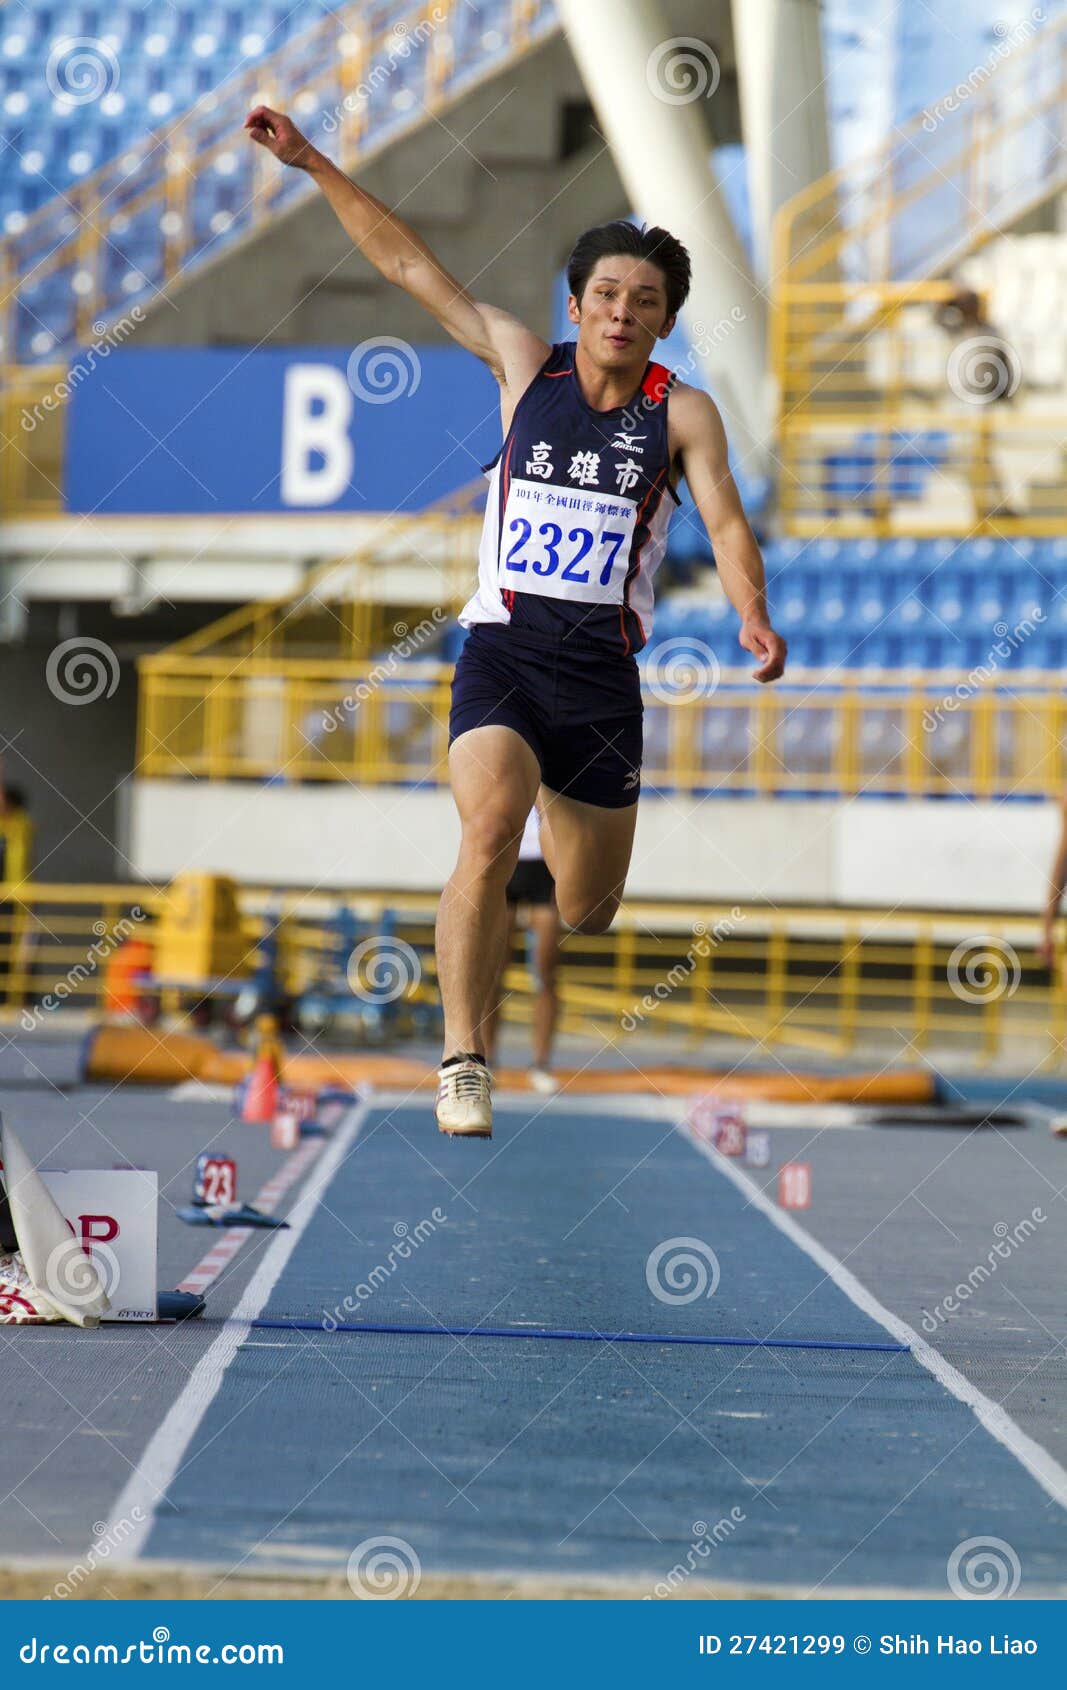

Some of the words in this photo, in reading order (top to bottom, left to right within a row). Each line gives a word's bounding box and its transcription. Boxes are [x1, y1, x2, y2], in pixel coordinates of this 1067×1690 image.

[281, 364, 354, 507] B
[525, 441, 643, 495] 高雄市
[505, 517, 626, 586] 2327
[205, 1164, 234, 1206] 23
